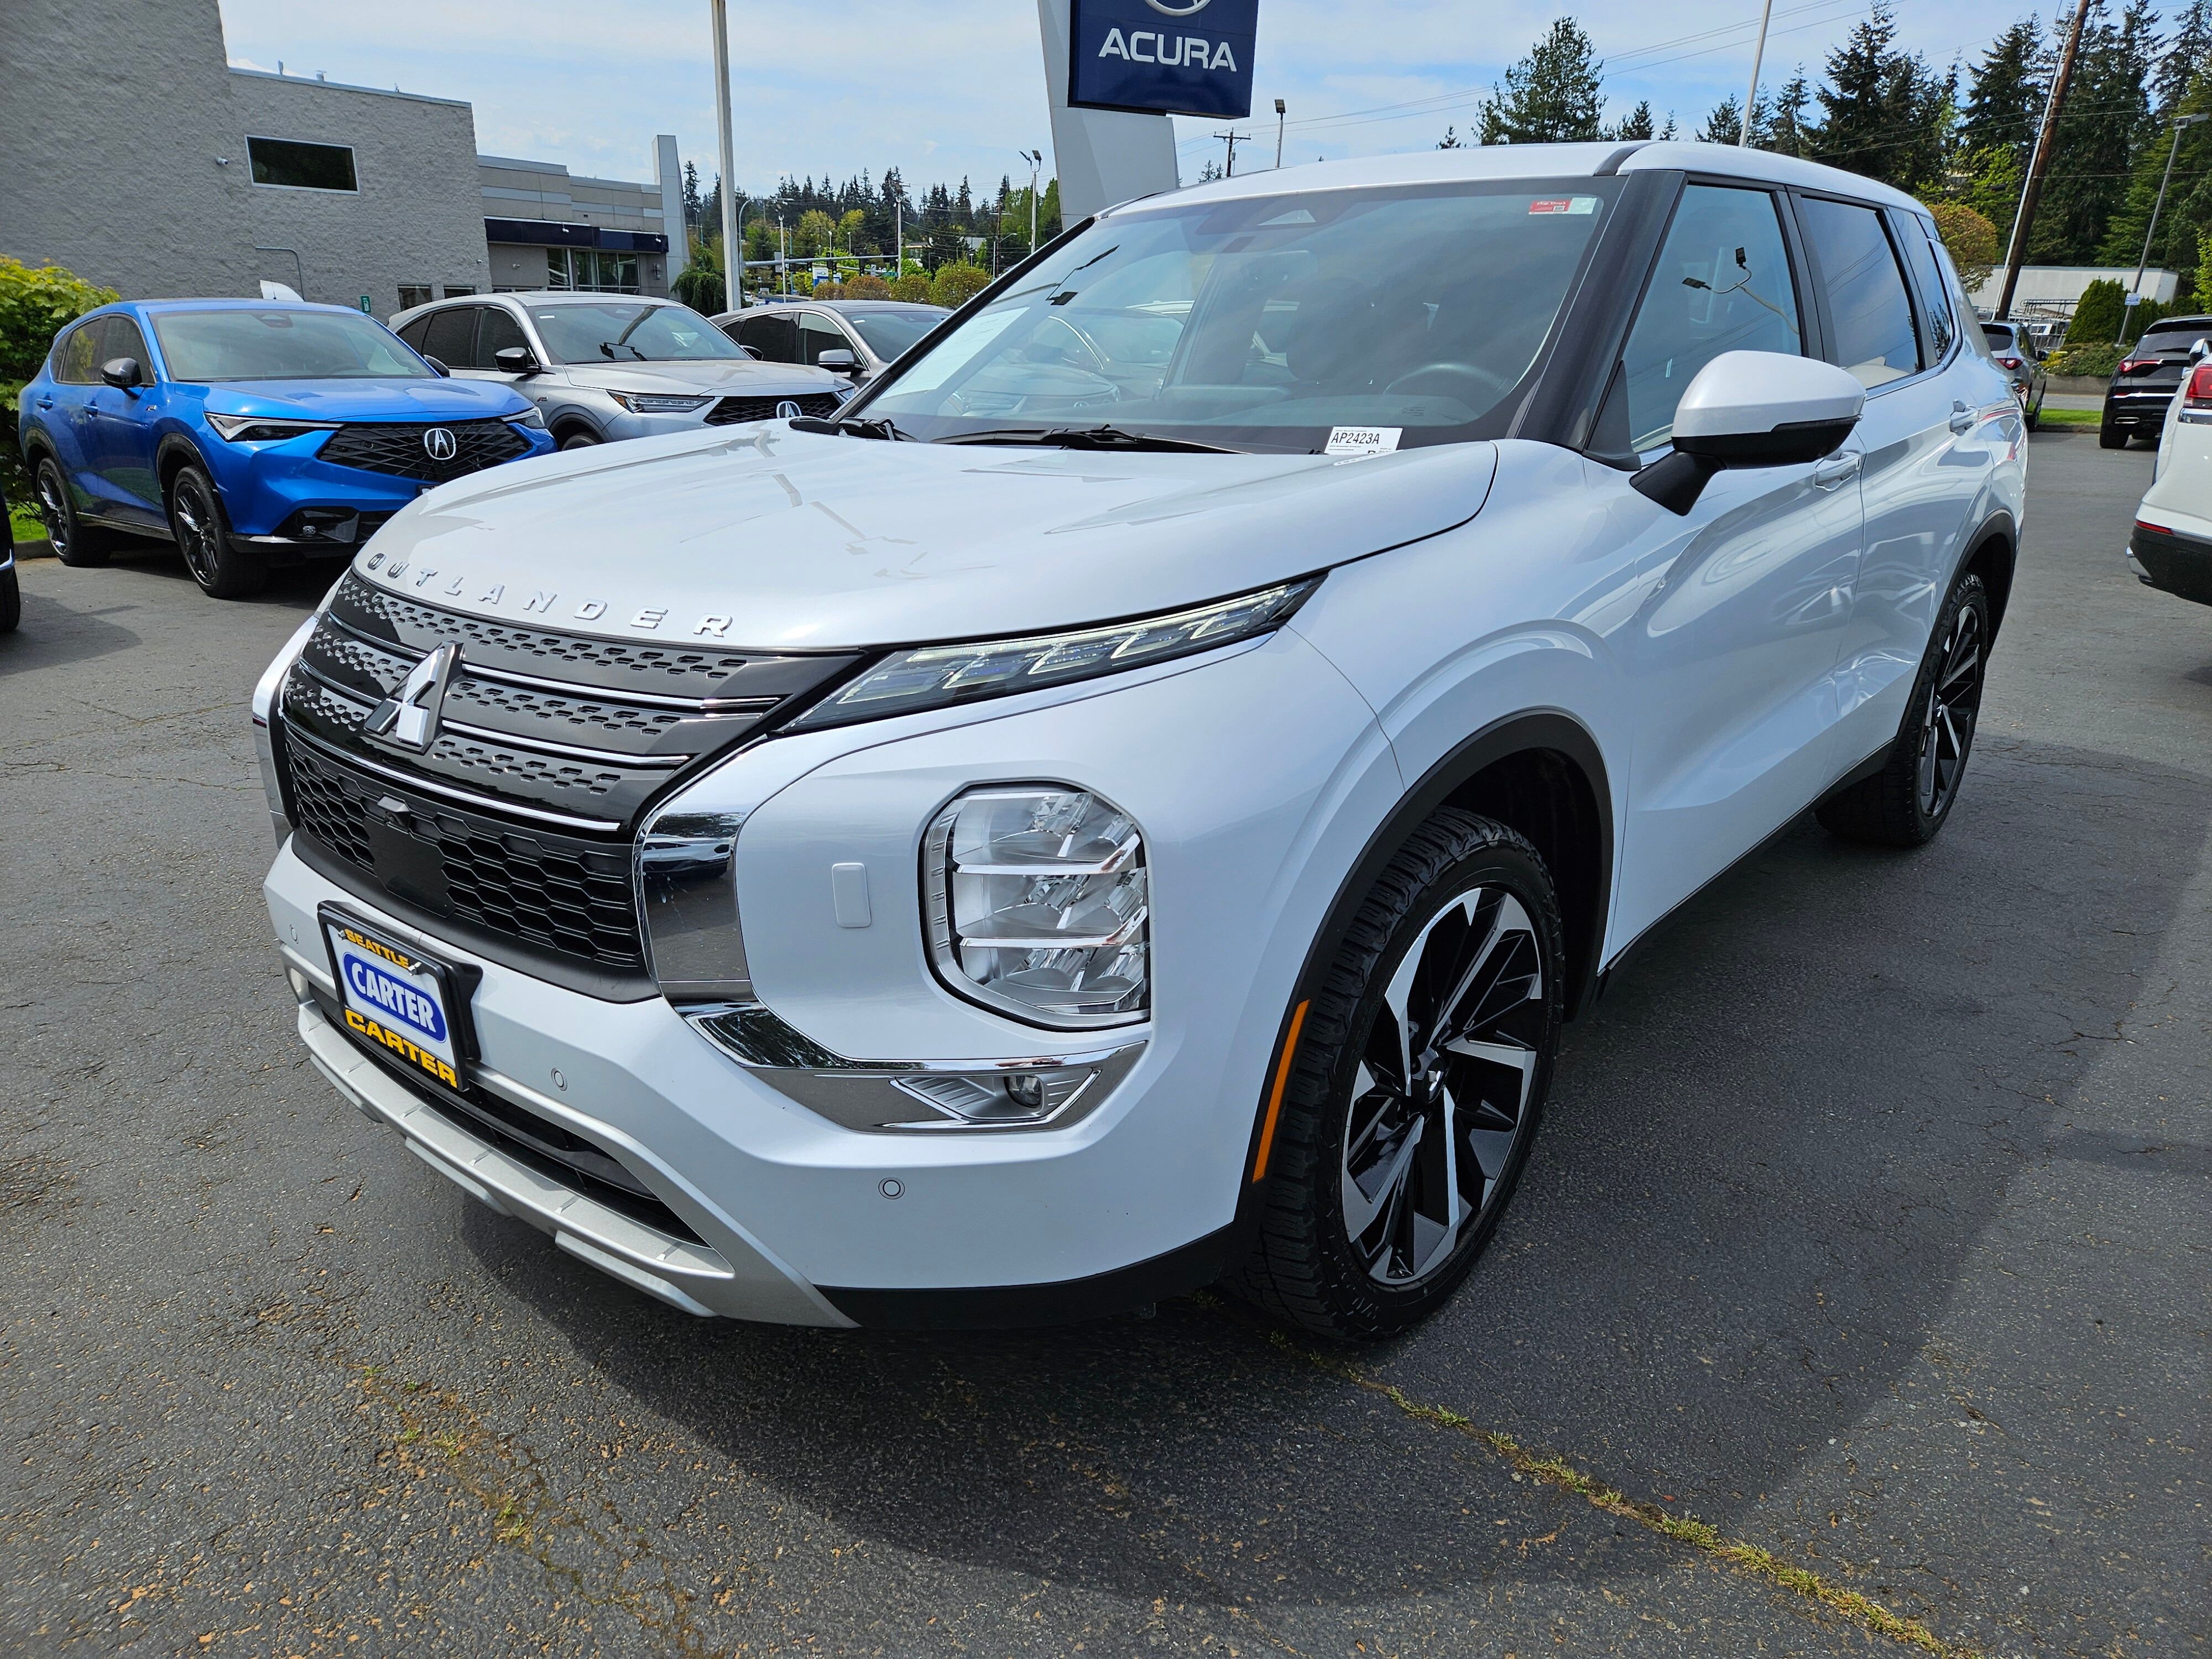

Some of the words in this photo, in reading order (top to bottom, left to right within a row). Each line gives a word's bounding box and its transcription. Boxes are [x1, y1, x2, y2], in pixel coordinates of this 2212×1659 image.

[1098, 28, 1238, 72] ACURA
[1331, 432, 1380, 445] AP2423A
[367, 553, 733, 637] OUTLANDER
[345, 928, 410, 969] SEATTLE
[352, 962, 436, 1033] CARTER
[345, 1009, 457, 1088] CARTER
